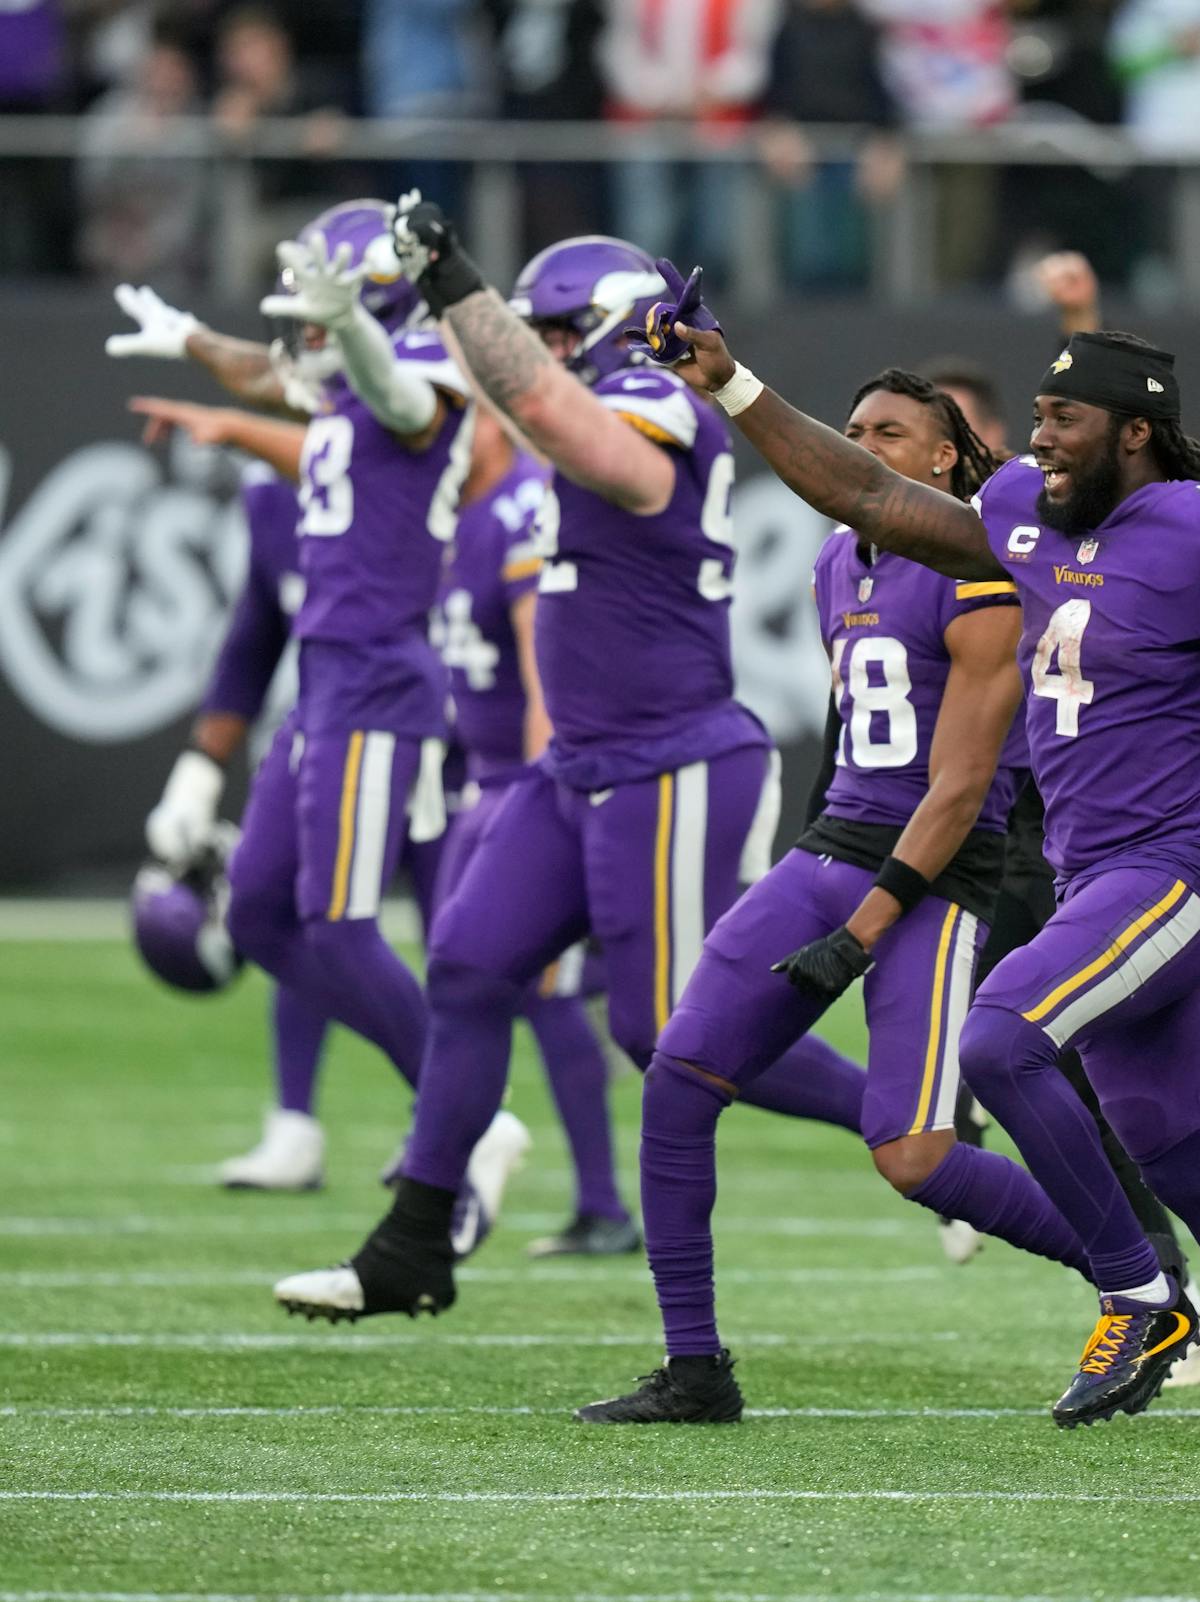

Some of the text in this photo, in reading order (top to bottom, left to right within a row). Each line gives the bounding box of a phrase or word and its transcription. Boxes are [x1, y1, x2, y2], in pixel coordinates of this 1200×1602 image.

[296, 415, 354, 537] 3
[1007, 525, 1041, 553] C
[1031, 598, 1095, 738] 4
